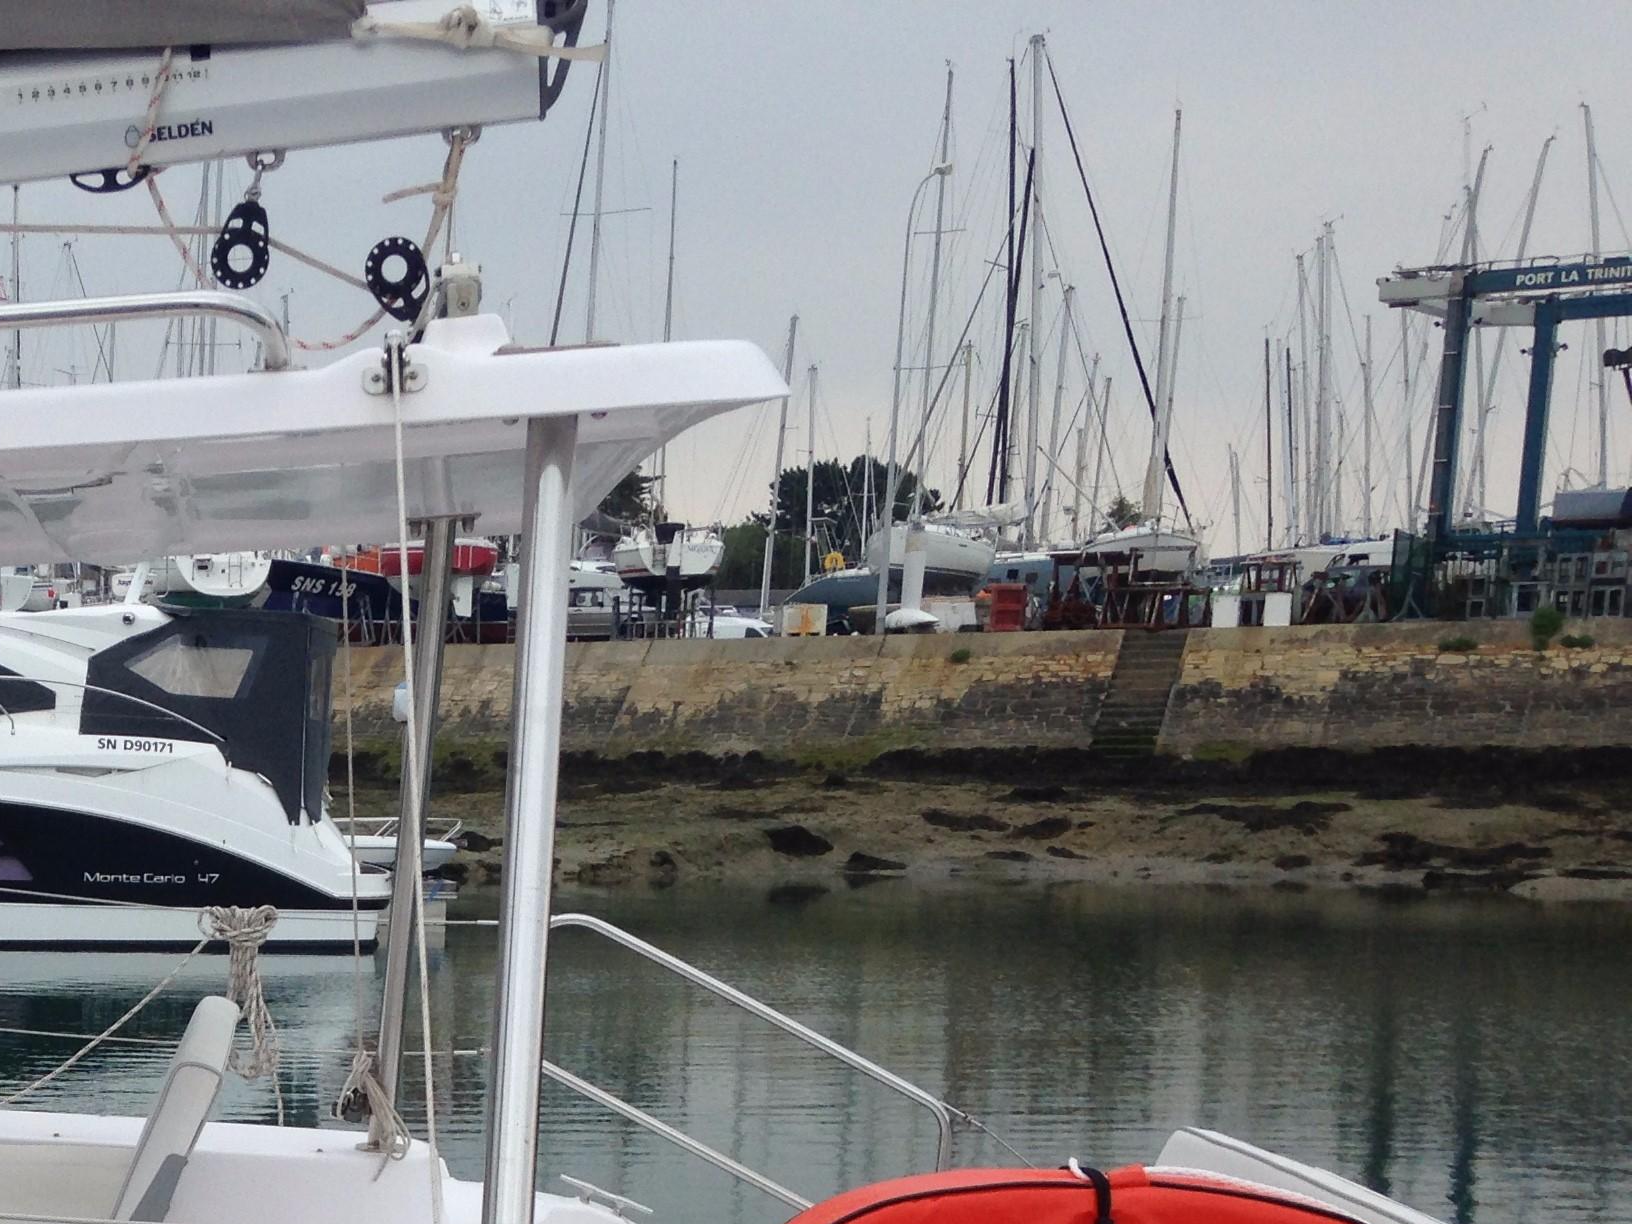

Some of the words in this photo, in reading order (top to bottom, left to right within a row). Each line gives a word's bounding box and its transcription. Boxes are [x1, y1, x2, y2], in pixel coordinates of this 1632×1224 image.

[1515, 271, 1555, 286] PORT
[1560, 270, 1579, 283] LA
[291, 576, 326, 593] SNS
[97, 738, 117, 750] SN
[123, 739, 174, 753] D90171
[83, 871, 141, 883] Monte
[143, 872, 186, 884] Carlo
[197, 873, 220, 884] 47
